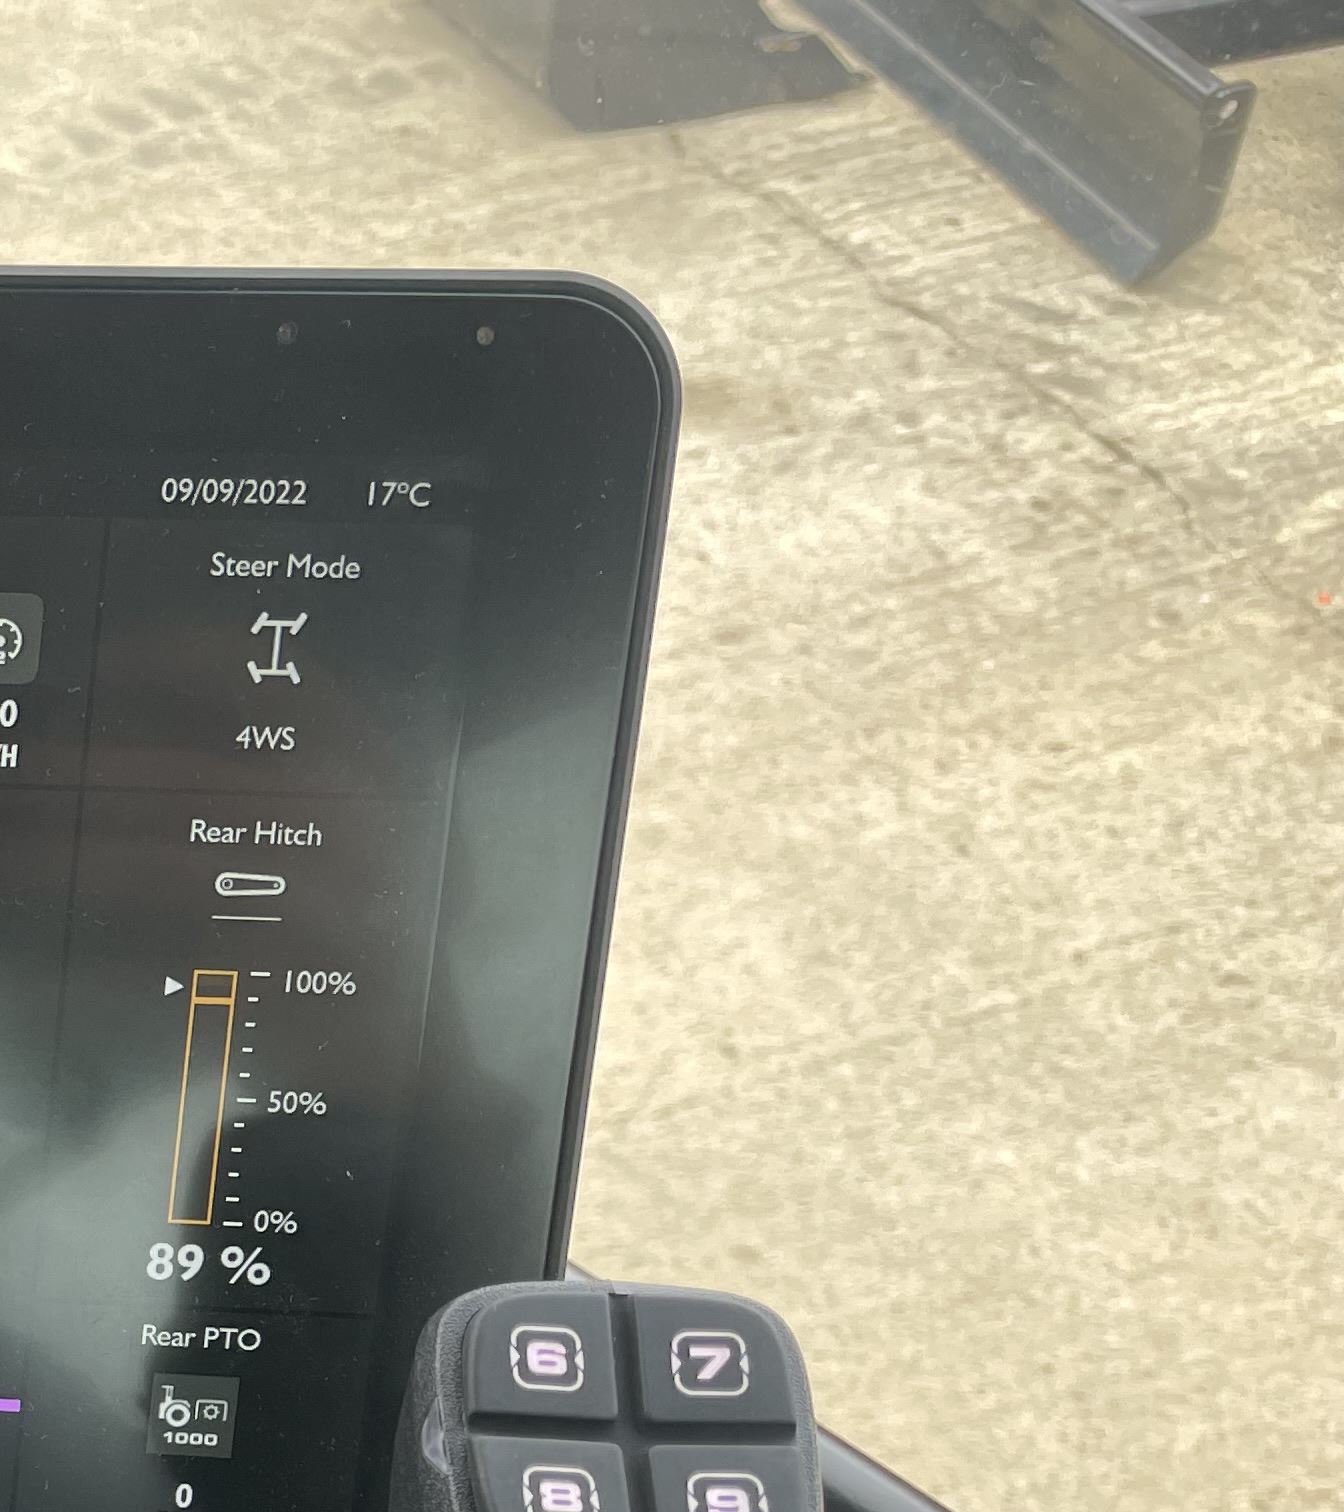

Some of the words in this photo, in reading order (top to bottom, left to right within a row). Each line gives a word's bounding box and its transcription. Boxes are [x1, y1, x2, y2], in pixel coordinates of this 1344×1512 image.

[161, 477, 307, 506] 09/09/2022
[209, 551, 279, 577] Steer
[286, 553, 361, 579] Mode
[235, 725, 295, 751] 4WS
[189, 818, 247, 844] Rear
[254, 820, 322, 846] Hitch
[285, 970, 357, 995] 100%
[267, 1090, 327, 1115] 50%
[253, 1209, 298, 1234] 0%
[145, 1242, 204, 1281] 89
[220, 1245, 271, 1286] %
[140, 1322, 197, 1348] Rear
[203, 1326, 262, 1351] PTO
[524, 1341, 568, 1377] 6
[688, 1345, 733, 1382] 7
[163, 1431, 218, 1446] 1000
[175, 1483, 193, 1509] 0
